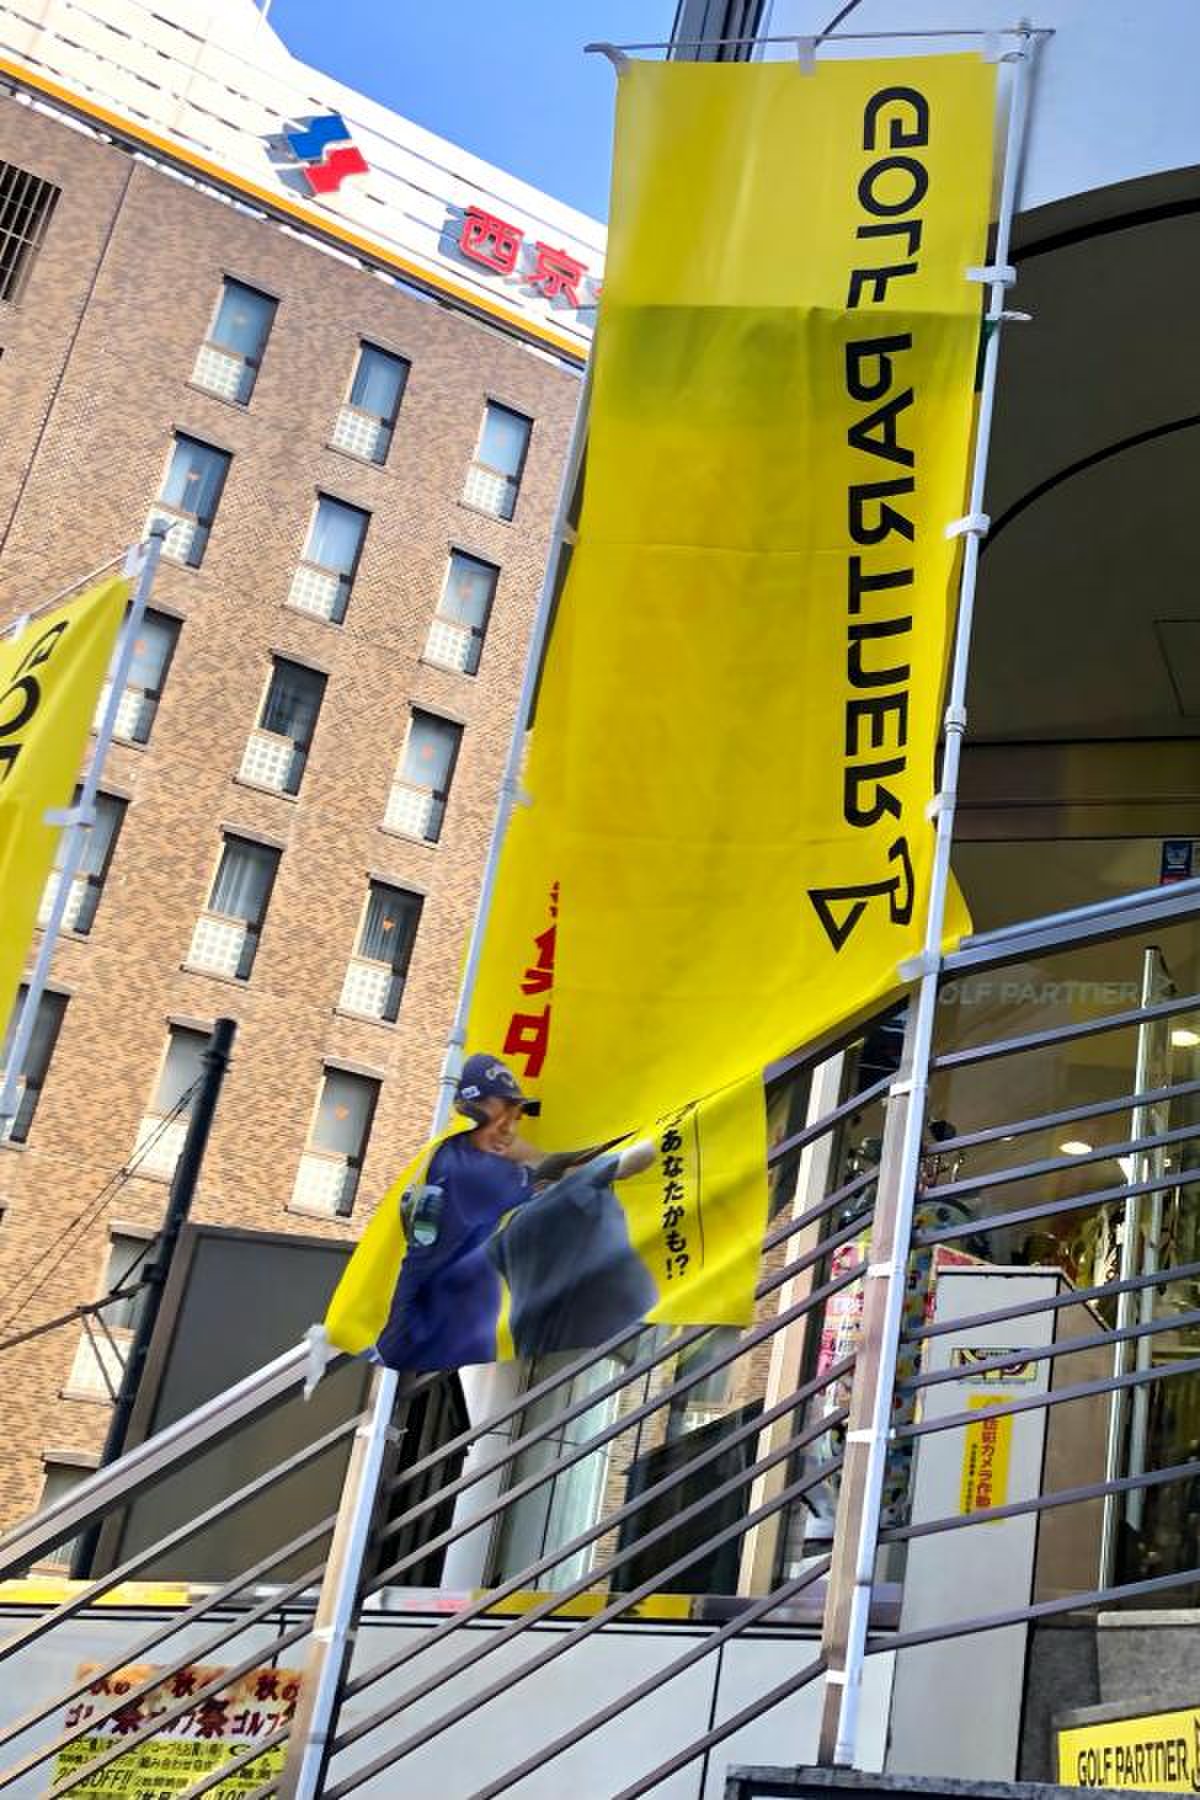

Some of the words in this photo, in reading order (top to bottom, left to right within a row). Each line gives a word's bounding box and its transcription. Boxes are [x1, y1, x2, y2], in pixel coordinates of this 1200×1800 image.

[459, 205, 603, 309] 西京
[937, 982, 993, 1006] OLF
[1077, 1747, 1113, 1787] GOLF
[1115, 1738, 1189, 1785] PARTNER
